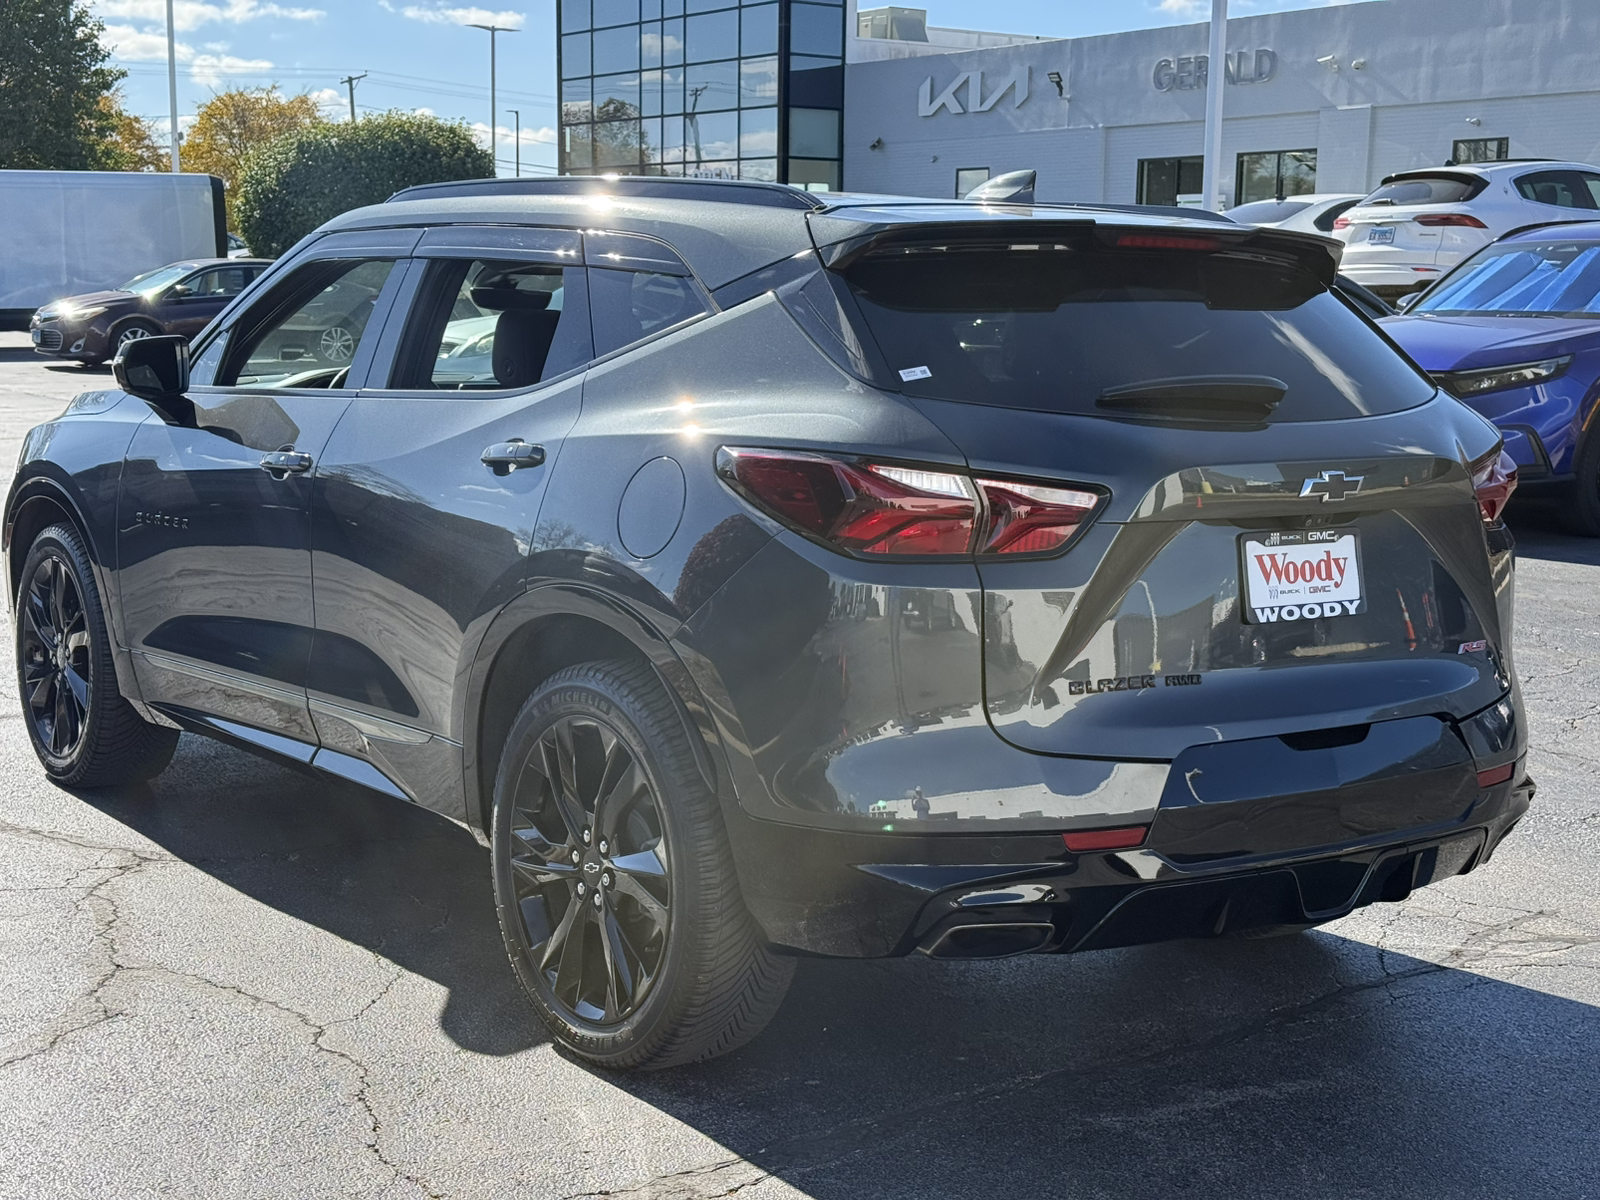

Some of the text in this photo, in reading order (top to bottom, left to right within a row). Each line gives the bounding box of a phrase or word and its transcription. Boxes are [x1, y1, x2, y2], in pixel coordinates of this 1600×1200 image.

[918, 65, 1031, 117] KIA
[1307, 531, 1335, 541] GMC
[1253, 550, 1349, 588] Woody
[1308, 585, 1332, 594] GMC
[1254, 600, 1361, 624] WOODY
[1457, 640, 1487, 655] RS
[1068, 673, 1203, 696] BLAZER AWD
[551, 691, 609, 713] MICHELIN
